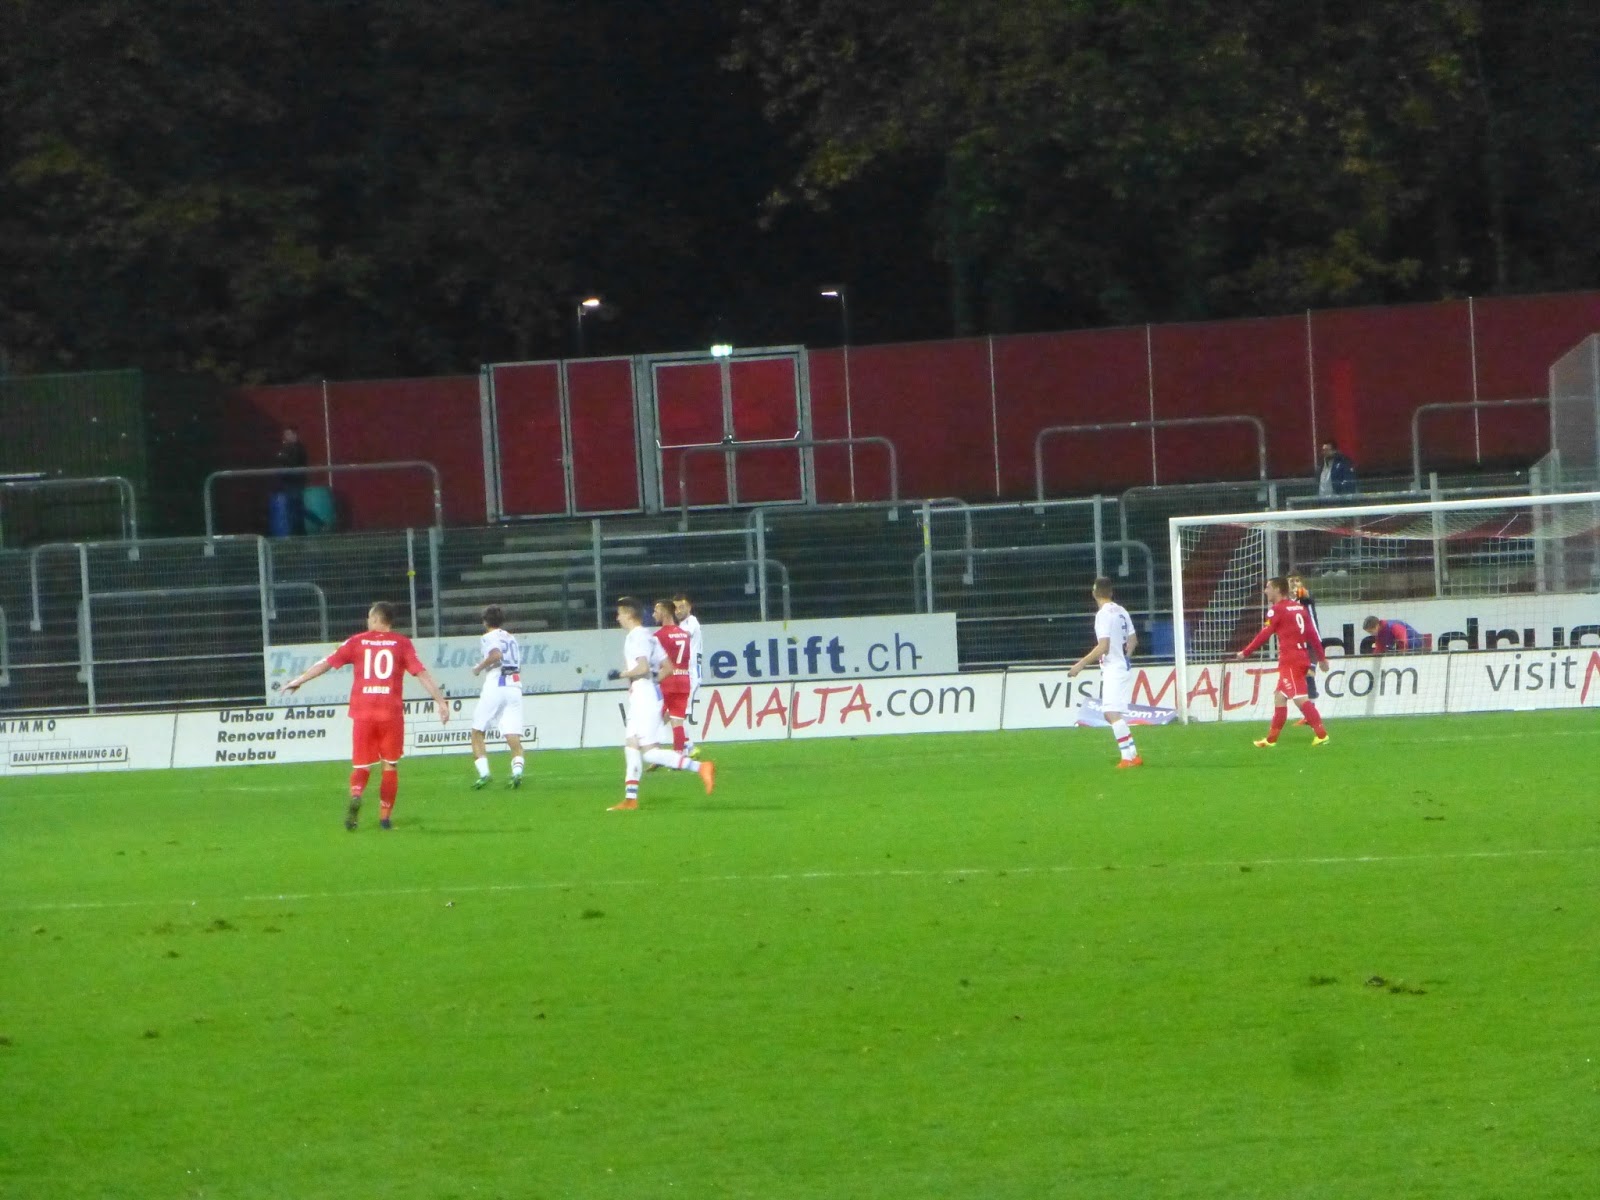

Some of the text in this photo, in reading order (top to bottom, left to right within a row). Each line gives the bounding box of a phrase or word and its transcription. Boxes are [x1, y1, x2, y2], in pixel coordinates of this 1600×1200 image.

[1295, 612, 1306, 635] 9
[675, 640, 686, 665] 7
[709, 632, 917, 679] etlift.ch
[363, 648, 394, 680] 10
[219, 705, 336, 723] Umbau Anbau
[403, 699, 463, 715] MIMO
[618, 683, 976, 741] tMALTA.com
[217, 726, 327, 743] Renovationen
[13, 747, 123, 763] BAUUNTERNEHMUNG AG
[215, 747, 277, 762] Neubau
